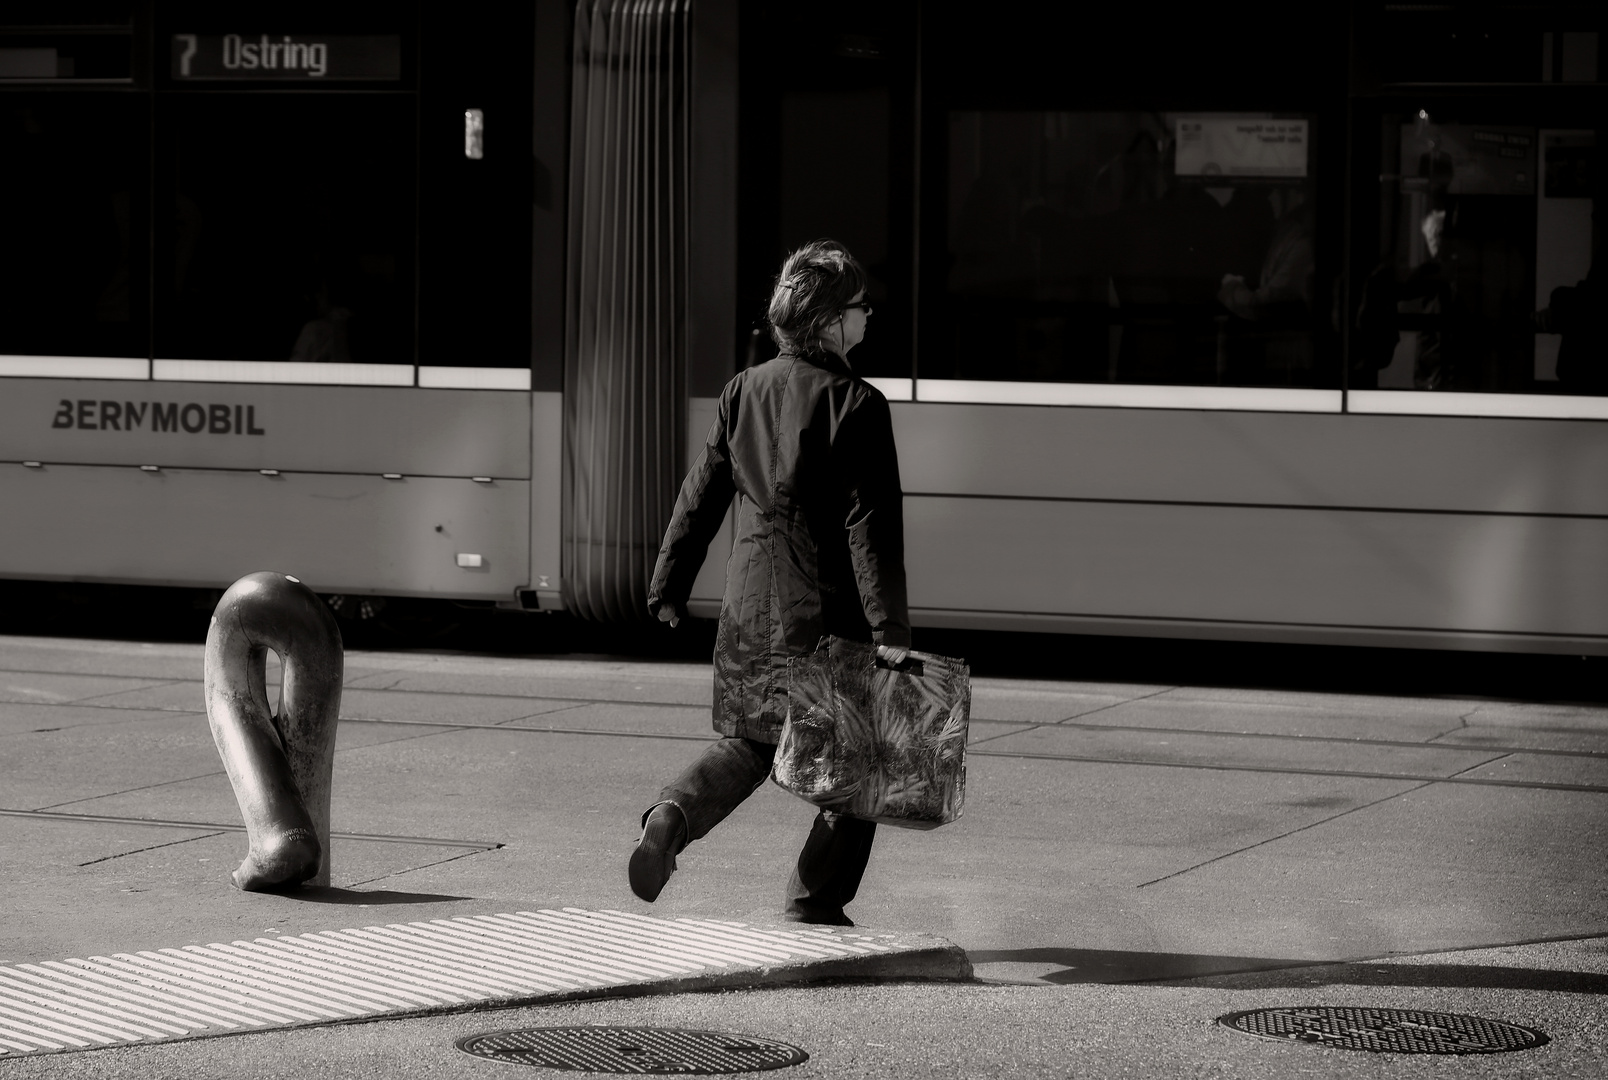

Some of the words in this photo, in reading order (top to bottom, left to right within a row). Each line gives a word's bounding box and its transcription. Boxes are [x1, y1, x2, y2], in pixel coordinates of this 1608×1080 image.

[173, 33, 198, 77] 7
[222, 33, 328, 77] Ostring
[52, 399, 265, 436] BERNMOBIL
